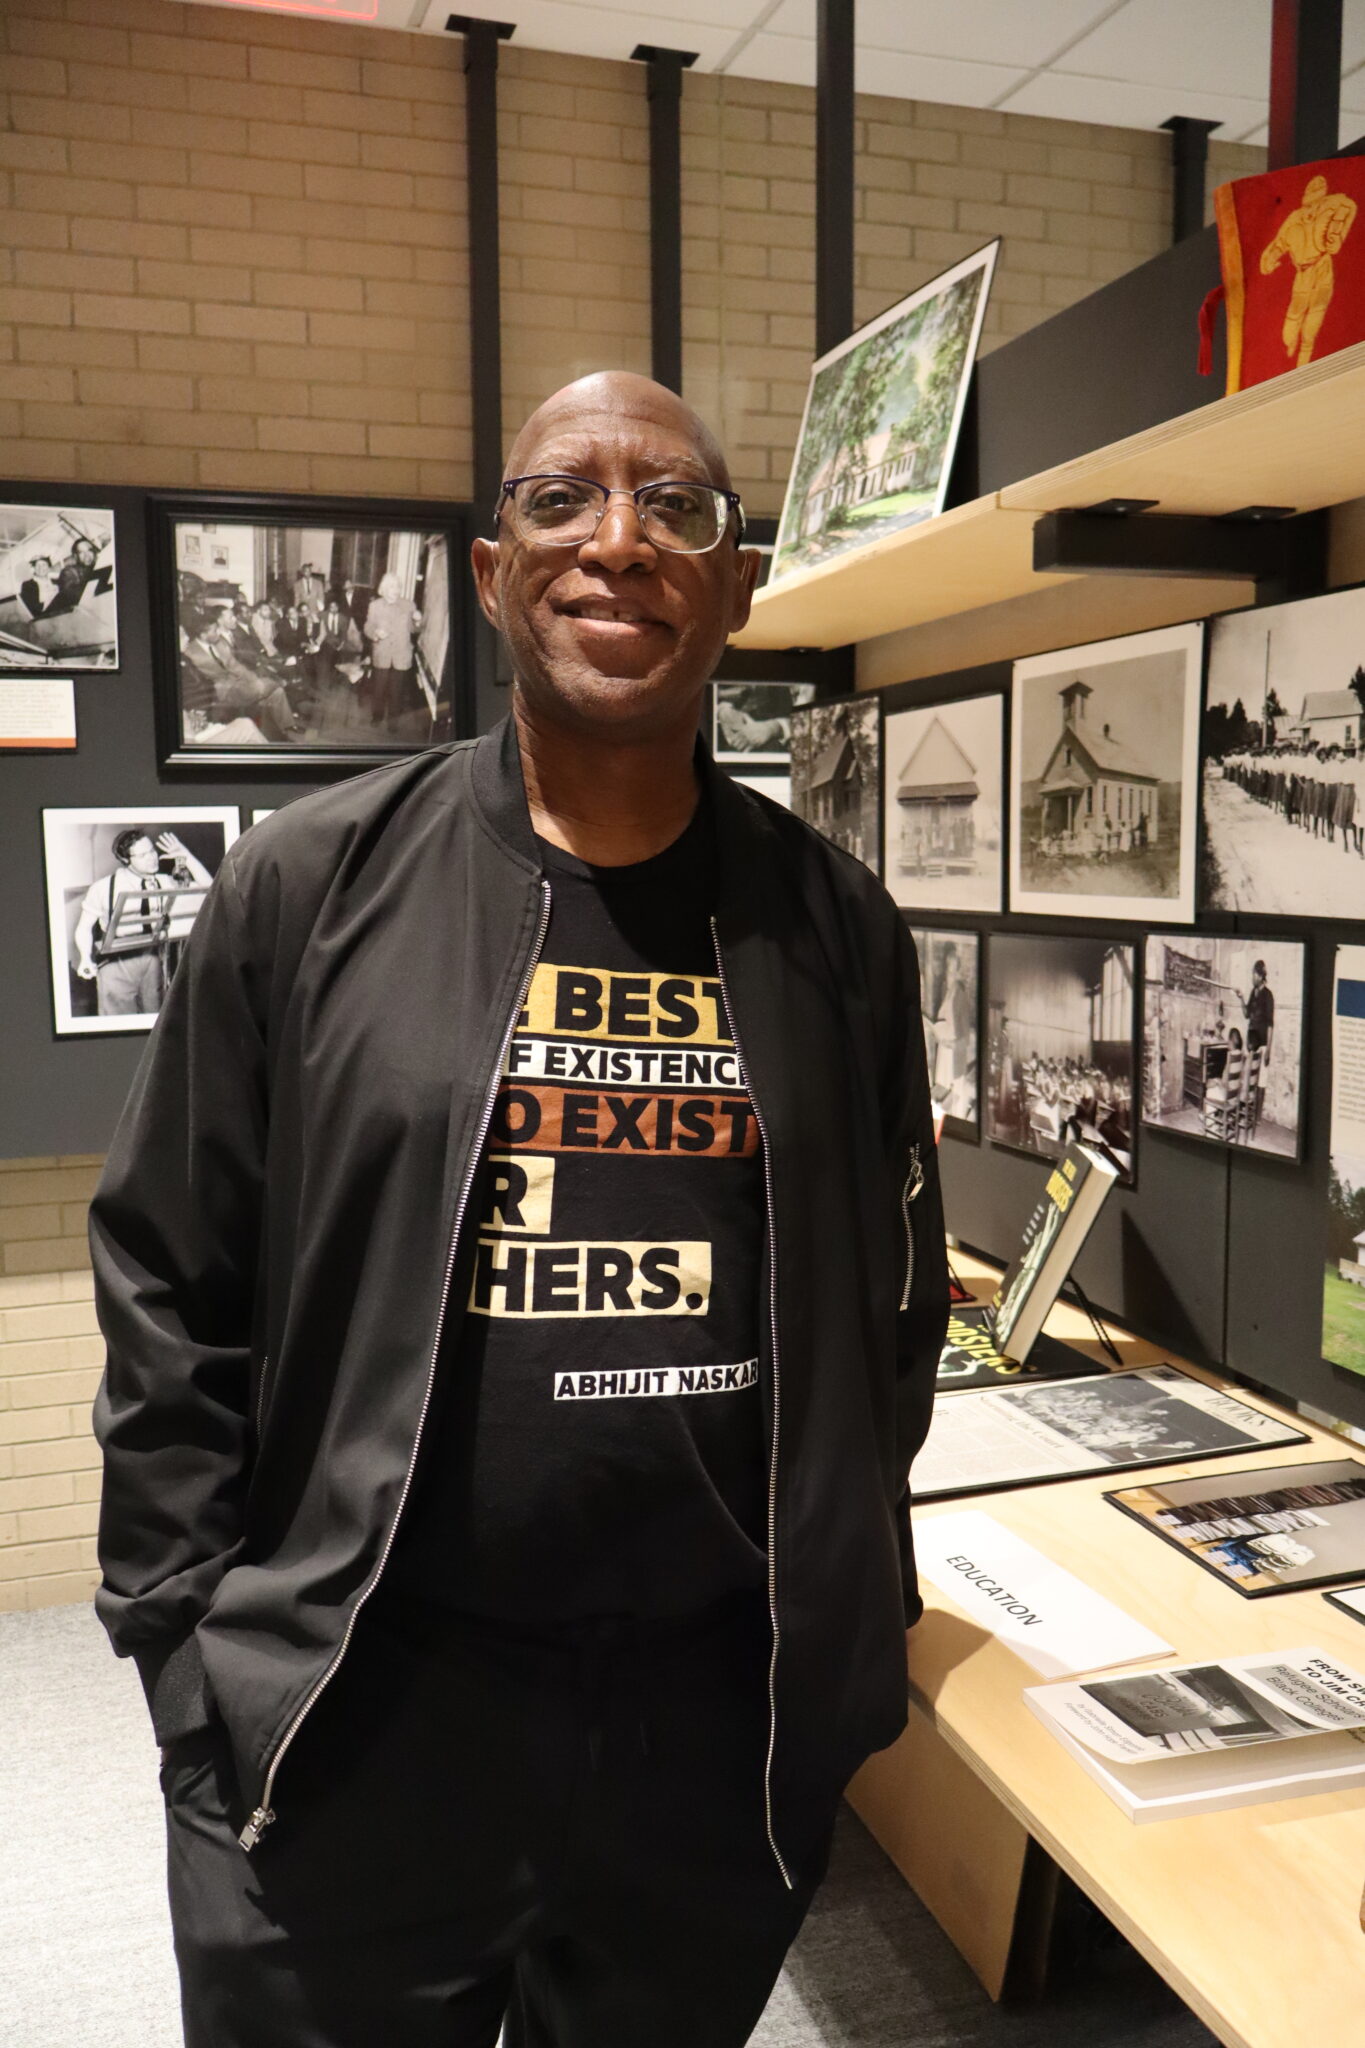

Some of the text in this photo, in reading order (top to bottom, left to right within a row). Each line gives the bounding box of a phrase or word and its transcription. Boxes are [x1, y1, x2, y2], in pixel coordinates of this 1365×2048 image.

[555, 971, 735, 1040] BEST
[544, 1045, 748, 1086] EXISTENC
[560, 1093, 756, 1152] EXIST
[475, 1245, 703, 1311] HERS.
[557, 1360, 758, 1398] ABHIJIT NASKAR
[946, 1555, 1043, 1626] EDUCATION
[1266, 1677, 1299, 1696] Black
[1271, 1666, 1317, 1694] Refugee
[1301, 1667, 1322, 1678] TO
[1319, 1680, 1349, 1695] JIM
[1308, 1659, 1351, 1682] FROM
